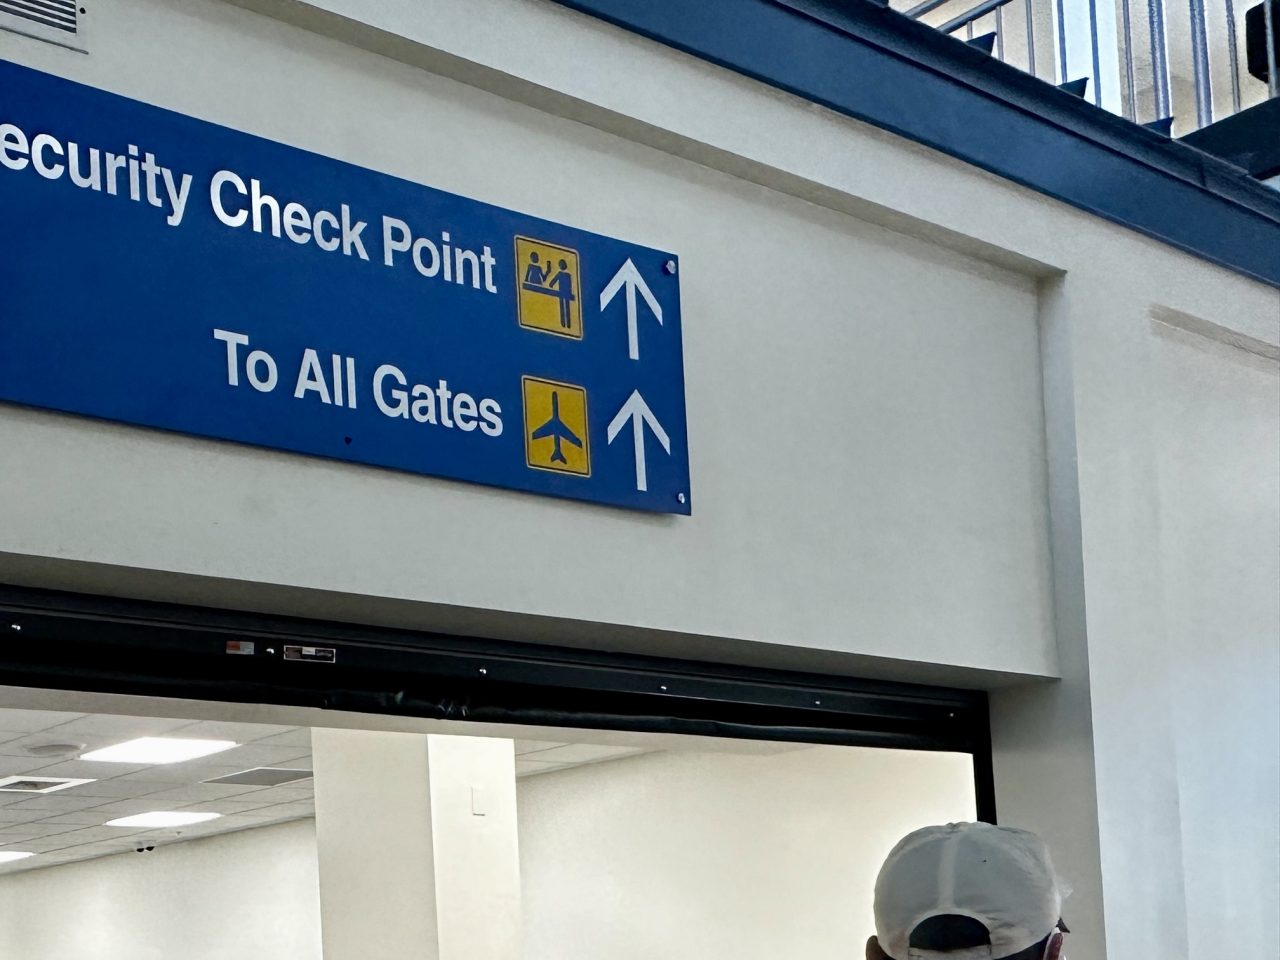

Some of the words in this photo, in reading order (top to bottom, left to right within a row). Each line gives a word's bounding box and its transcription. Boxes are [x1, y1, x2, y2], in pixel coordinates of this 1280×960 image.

[210, 170, 369, 260] Check
[383, 216, 497, 293] Point
[214, 329, 277, 392] To
[294, 349, 356, 408] All
[373, 365, 503, 436] Gates
